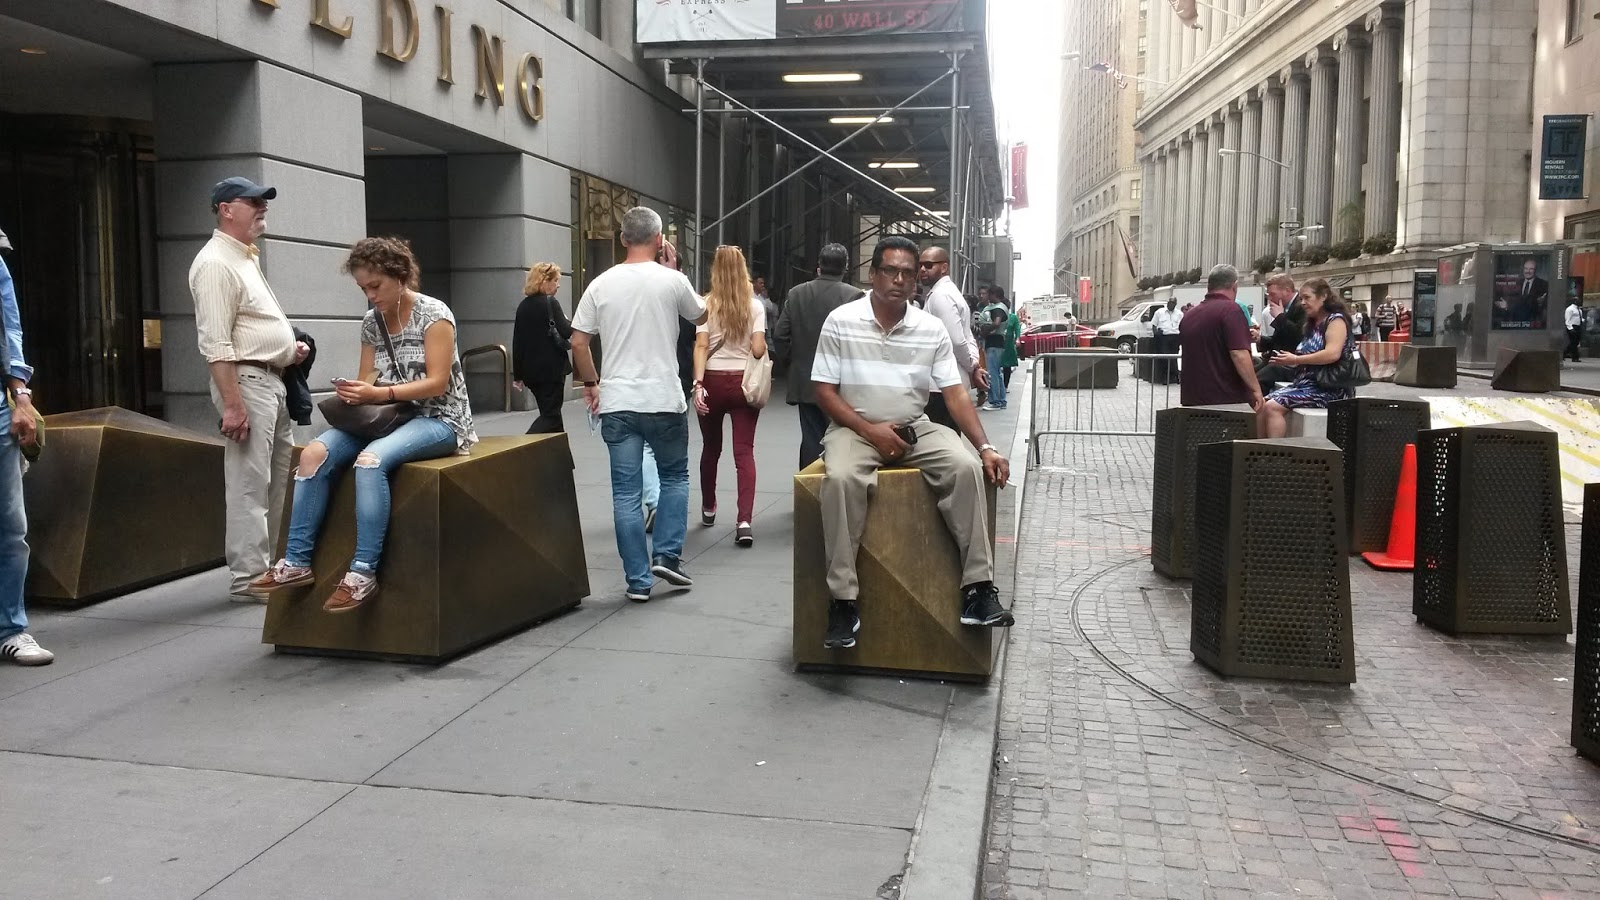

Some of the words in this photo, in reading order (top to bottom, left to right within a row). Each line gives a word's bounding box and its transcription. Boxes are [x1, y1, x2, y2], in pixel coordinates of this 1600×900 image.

[814, 12, 834, 30] 40
[842, 11, 897, 29] WALL
[905, 9, 929, 26] ST
[248, 0, 544, 122] LDING
